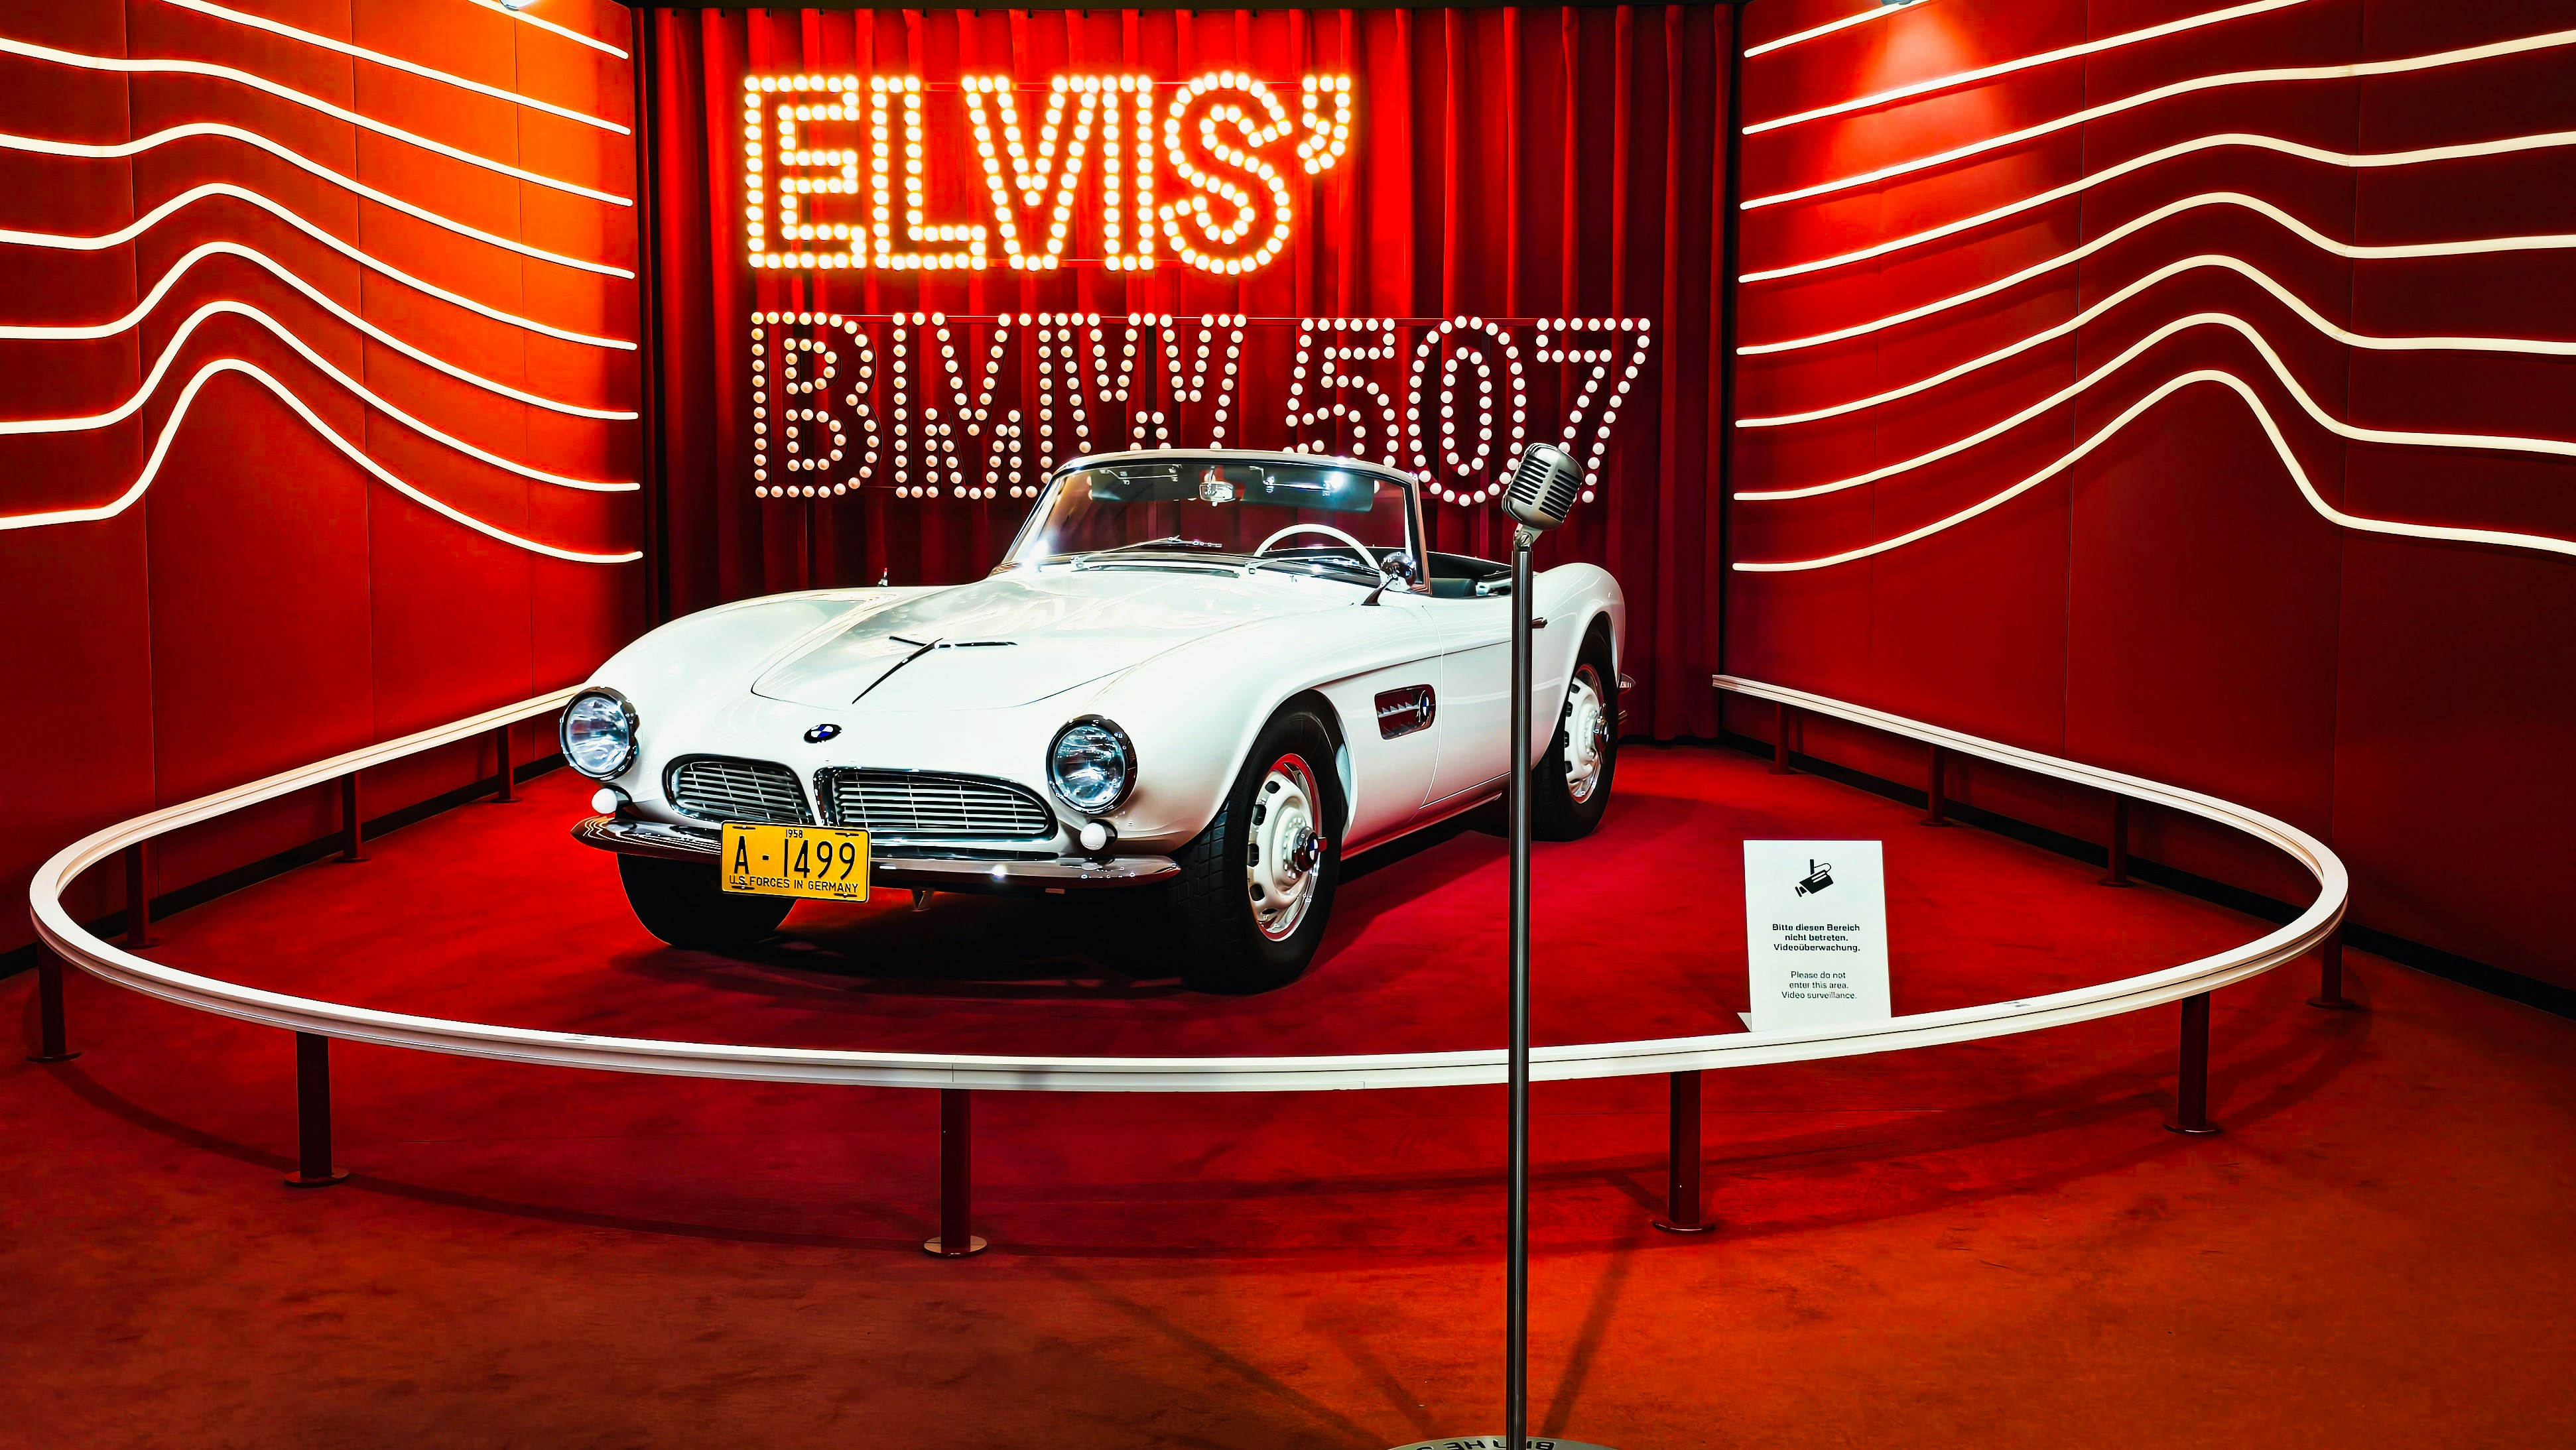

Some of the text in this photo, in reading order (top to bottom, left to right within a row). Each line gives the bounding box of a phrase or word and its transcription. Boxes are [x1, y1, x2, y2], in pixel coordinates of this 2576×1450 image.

[751, 311, 1651, 507] BMW 507
[786, 829, 803, 839] 1958
[749, 876, 790, 888] FORCES
[794, 879, 803, 889] IN
[808, 880, 859, 893] GERMANY
[1773, 943, 1860, 952] Videoüberwachung.
